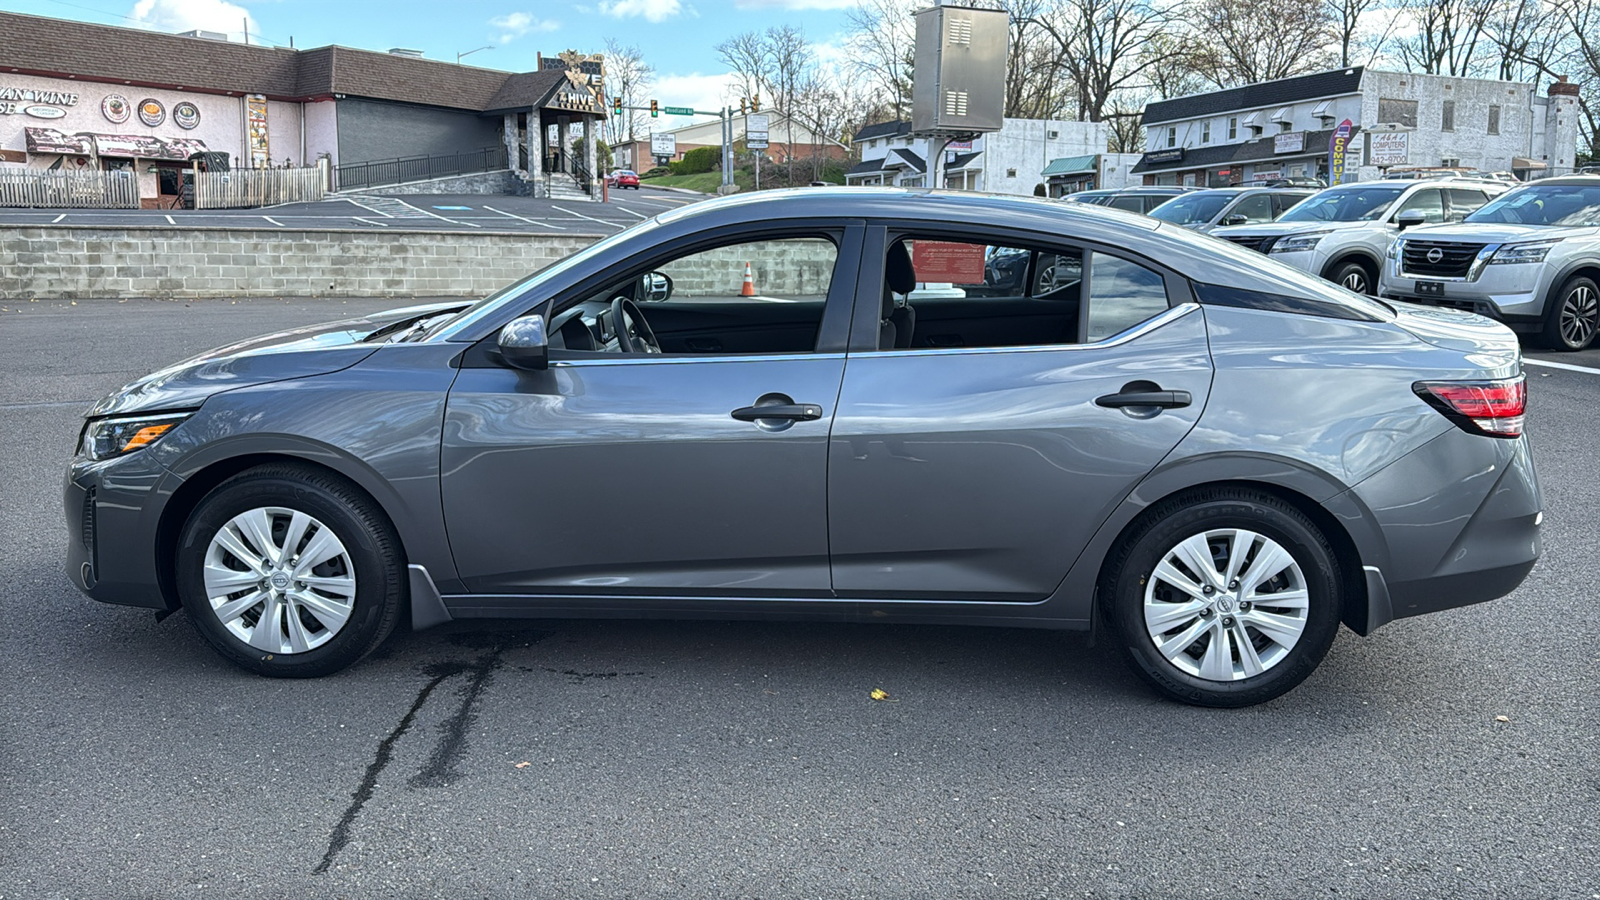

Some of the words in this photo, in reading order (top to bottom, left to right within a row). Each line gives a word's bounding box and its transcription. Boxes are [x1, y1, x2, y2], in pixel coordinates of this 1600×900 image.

[0, 86, 29, 101] AN
[32, 90, 79, 106] WINE
[568, 92, 596, 106] HIVE
[1372, 141, 1406, 149] COMPUTERS
[1371, 155, 1407, 165] 942-9700
